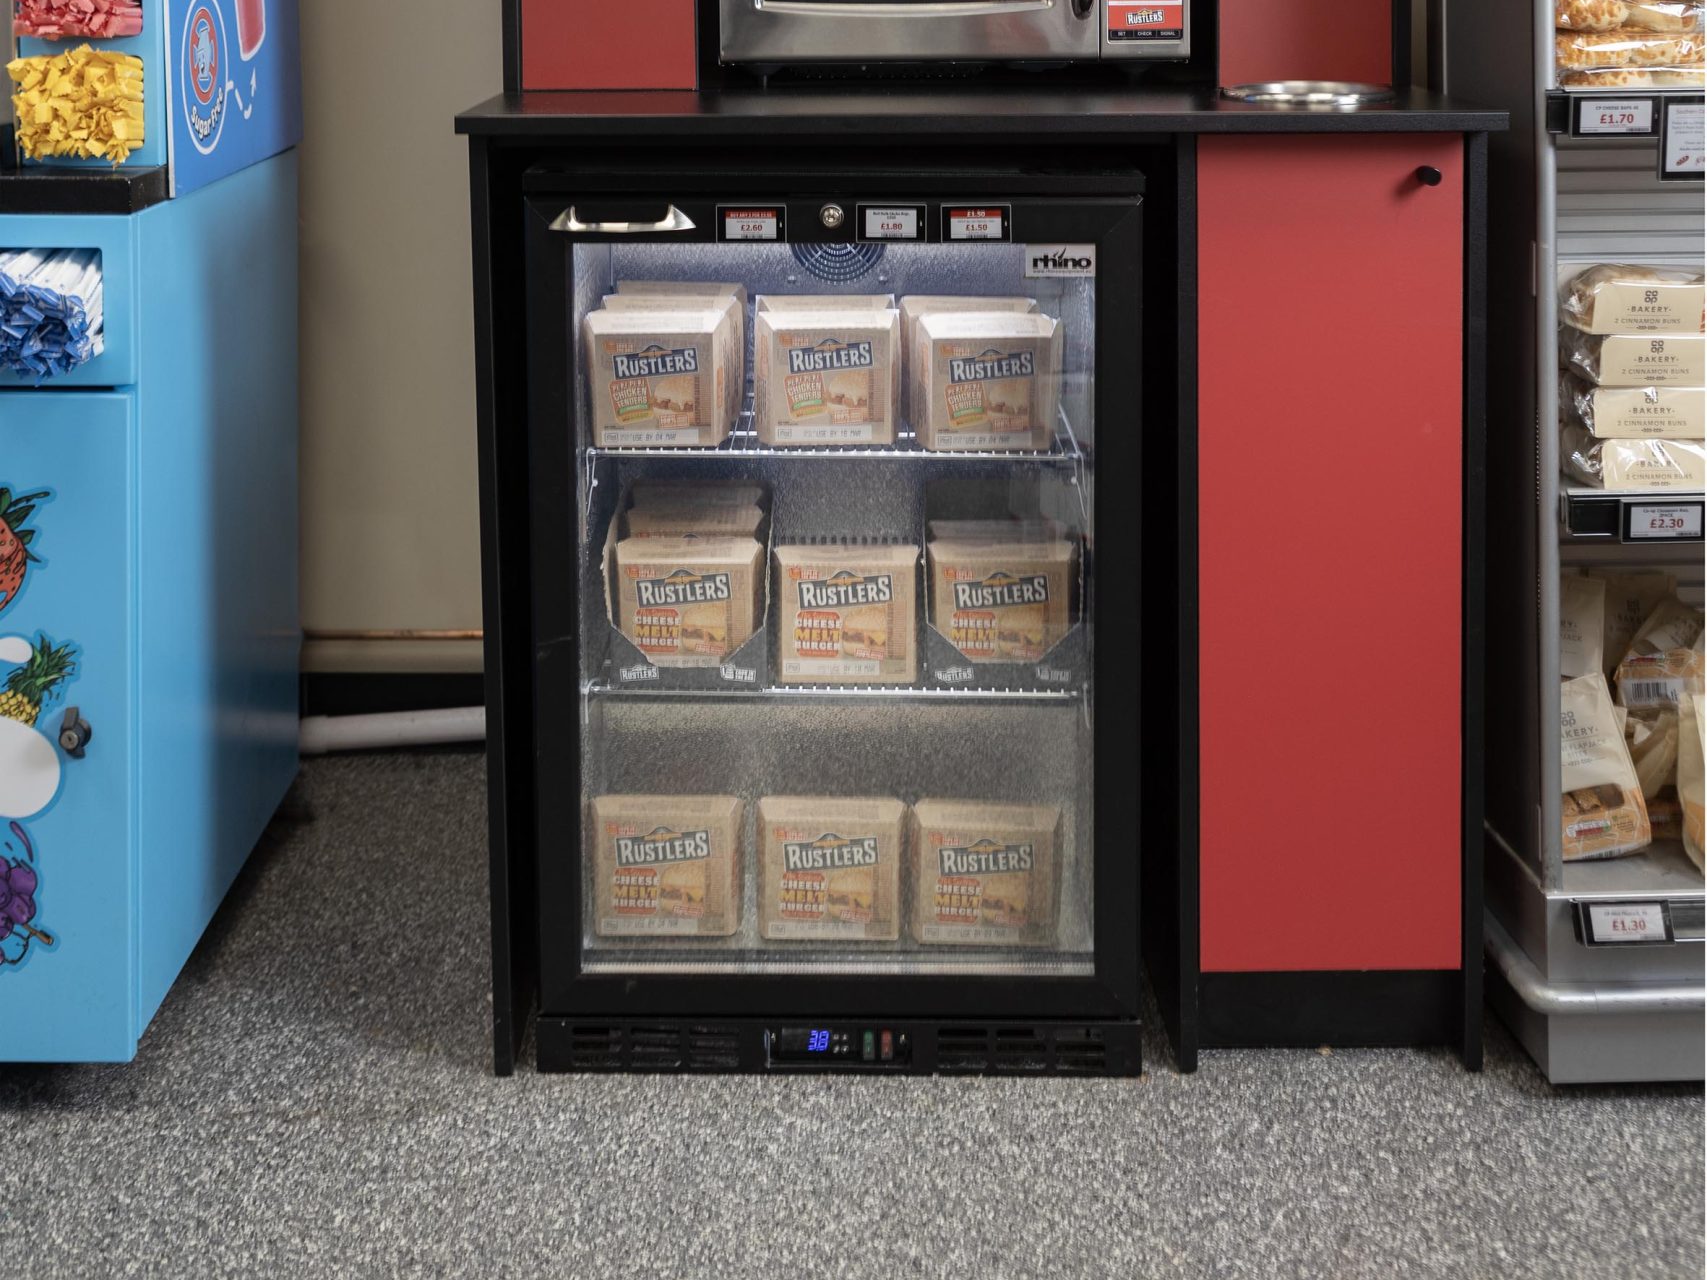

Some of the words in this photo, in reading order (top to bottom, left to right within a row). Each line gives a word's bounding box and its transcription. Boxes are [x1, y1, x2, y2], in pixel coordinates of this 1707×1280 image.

[1128, 11, 1163, 24] RUSTLERS
[191, 105, 211, 139] Sugar
[1600, 114, 1634, 124] £1.70
[967, 210, 985, 218] £1.50
[741, 224, 763, 232] £2.60
[881, 223, 903, 231] £1.80
[1033, 250, 1092, 269] rhino
[615, 349, 696, 377] RUSTLERS
[791, 343, 870, 372] RUSTLERS
[952, 353, 1032, 381] RUSTLERS
[613, 387, 647, 401] CHICKEN
[788, 382, 822, 396] CHICKEN
[949, 392, 982, 405] CHICKEN
[1650, 518, 1684, 528] £2.30
[639, 575, 729, 605] RUSTLERS
[801, 576, 890, 607] RUSTLERS
[957, 577, 1045, 608] RUSTLERS
[634, 616, 681, 625] CHEESE
[795, 619, 842, 628] CHEESE
[952, 619, 996, 628] CHEESE
[636, 626, 680, 638] MELT
[794, 629, 840, 641] MELT
[951, 628, 995, 640] MELT
[622, 666, 658, 680] RUSTLERS
[937, 668, 973, 681] RUSTLERS
[619, 832, 708, 863] RUSTLERS
[787, 839, 876, 869] RUSTLERS
[942, 845, 1031, 873] RUSTLERS
[613, 876, 660, 885] CHEESE
[781, 880, 826, 889] CHEESE
[614, 886, 657, 898] MELT
[781, 890, 825, 902] MELT
[936, 885, 983, 895] CHEESE
[934, 895, 980, 908] MELT
[1612, 920, 1646, 931] £1.30
